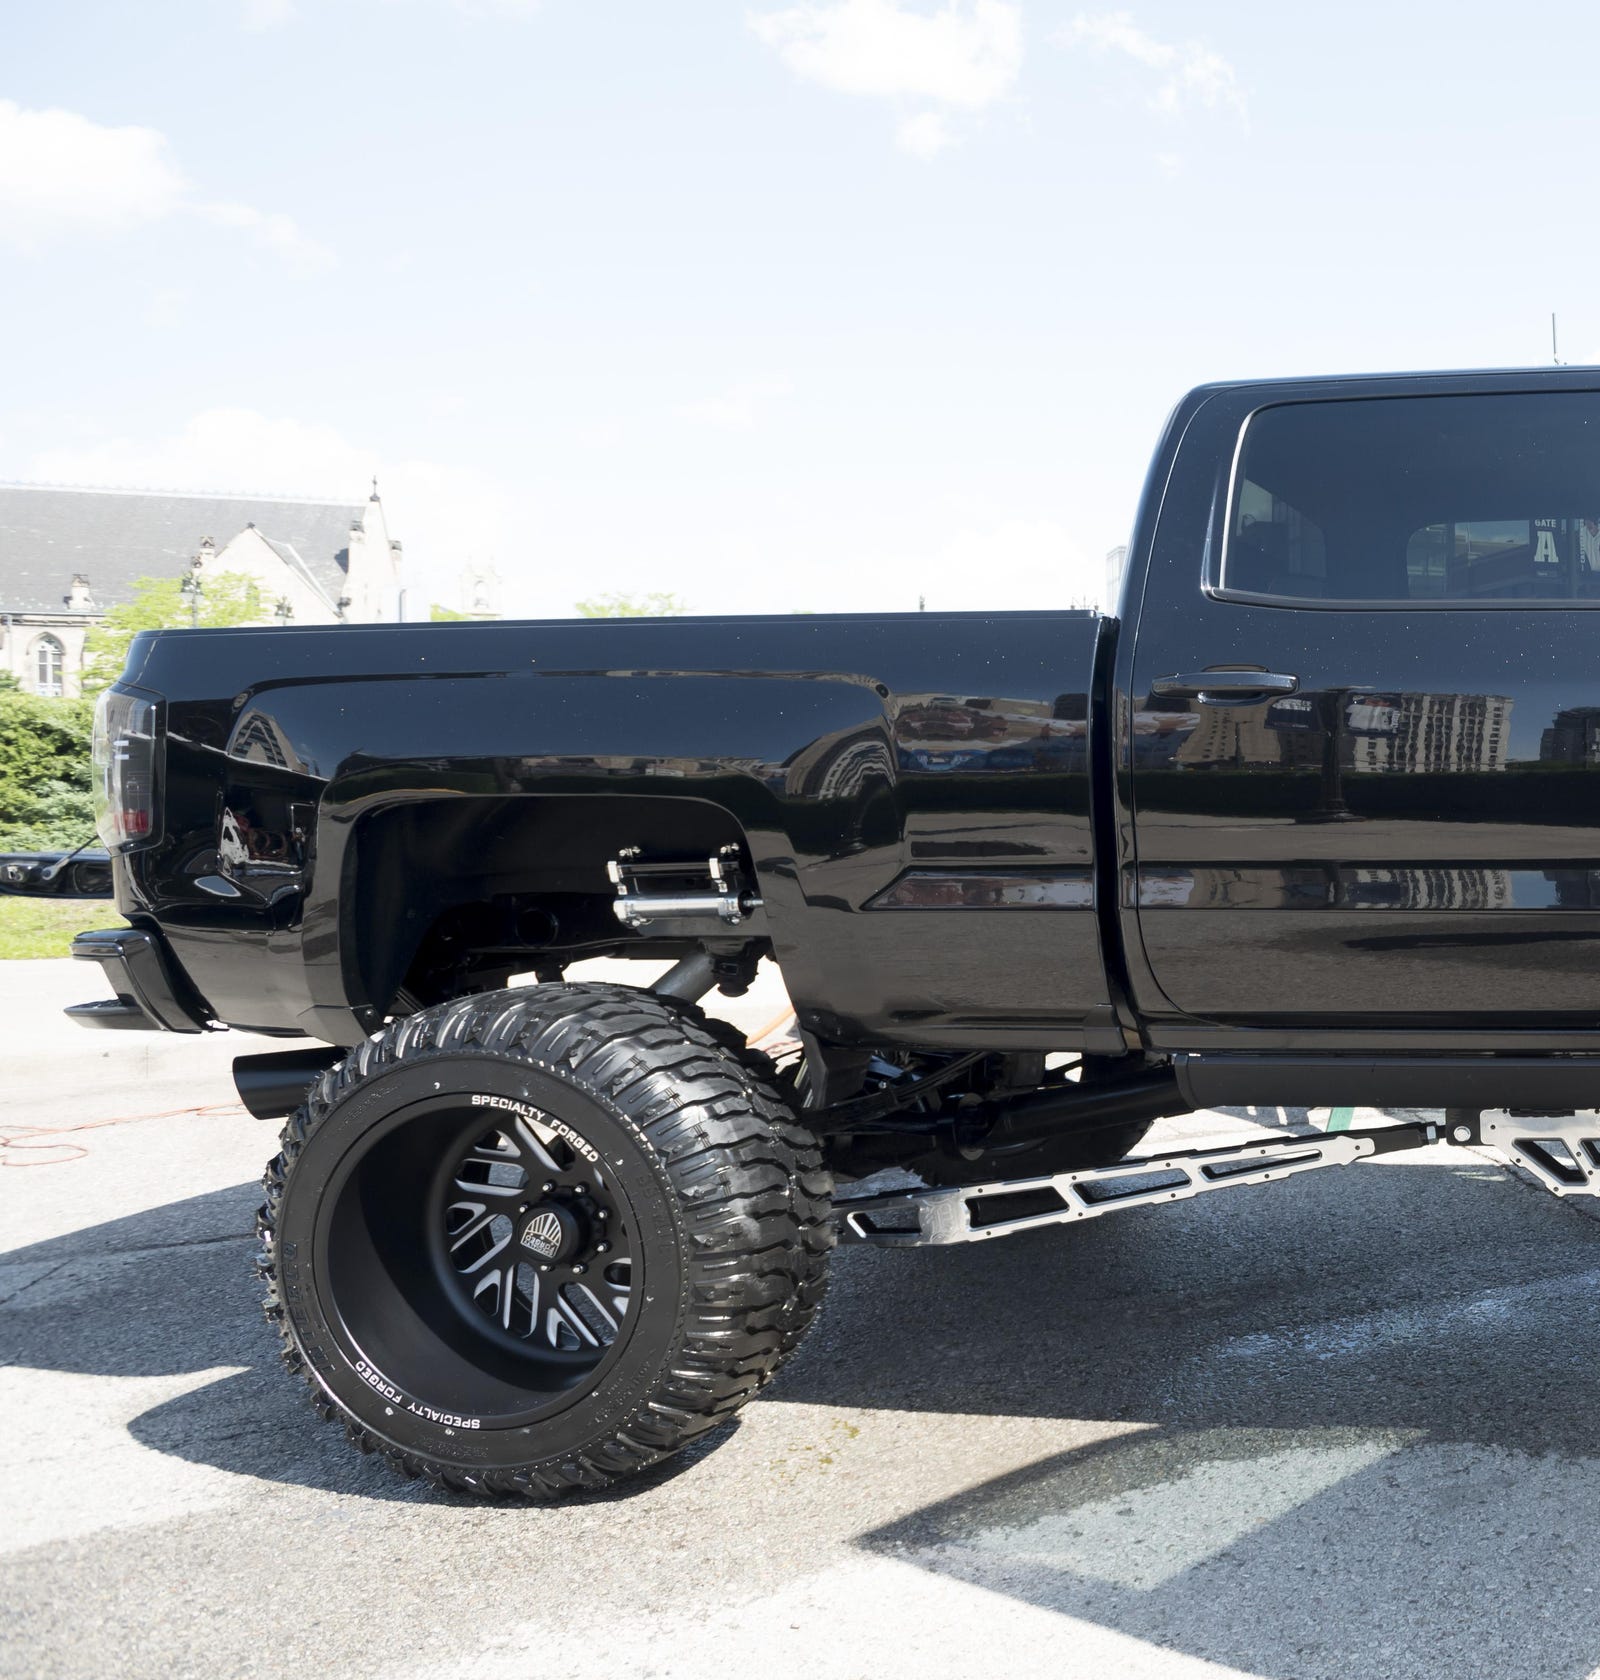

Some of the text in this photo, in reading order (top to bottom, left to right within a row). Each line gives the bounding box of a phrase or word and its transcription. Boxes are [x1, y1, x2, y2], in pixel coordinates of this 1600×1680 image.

[1534, 519, 1557, 528] GATE
[1534, 531, 1559, 563] A
[472, 1095, 598, 1162] SPECIALTY FORGED
[355, 1361, 481, 1429] SPECIALTY FORGED
